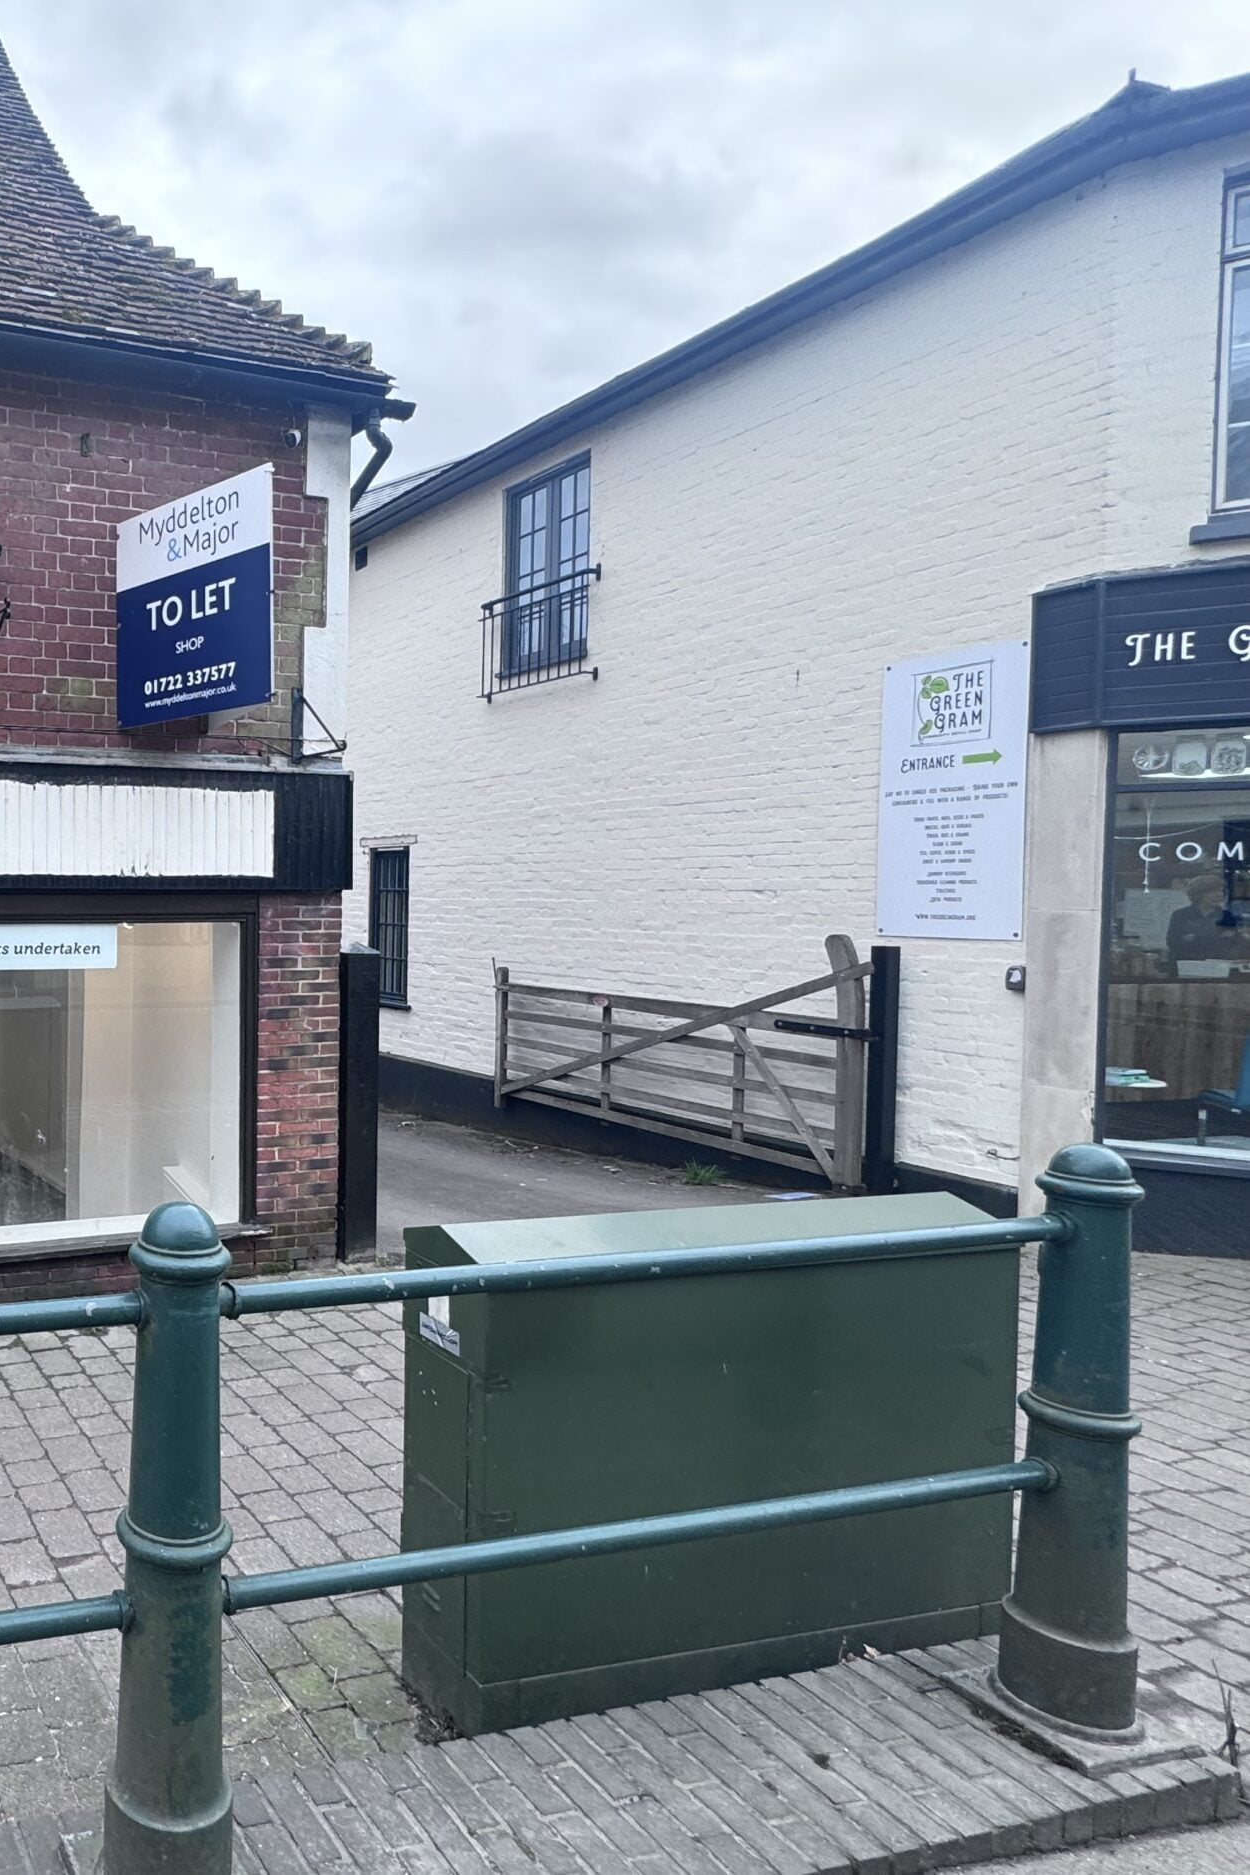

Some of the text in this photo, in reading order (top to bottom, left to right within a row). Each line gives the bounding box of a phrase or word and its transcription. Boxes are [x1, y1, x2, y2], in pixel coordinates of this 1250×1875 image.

[139, 490, 239, 546] Myddelton
[146, 577, 236, 631] TO LET
[175, 636, 204, 654] SHOP
[1125, 631, 1196, 667] THE
[144, 661, 236, 695] 01722 337577
[953, 670, 985, 692] THE
[930, 690, 983, 715] GREEN
[934, 709, 982, 733] GRAM
[1138, 841, 1244, 862] COM
[14, 941, 101, 956] undertaken
